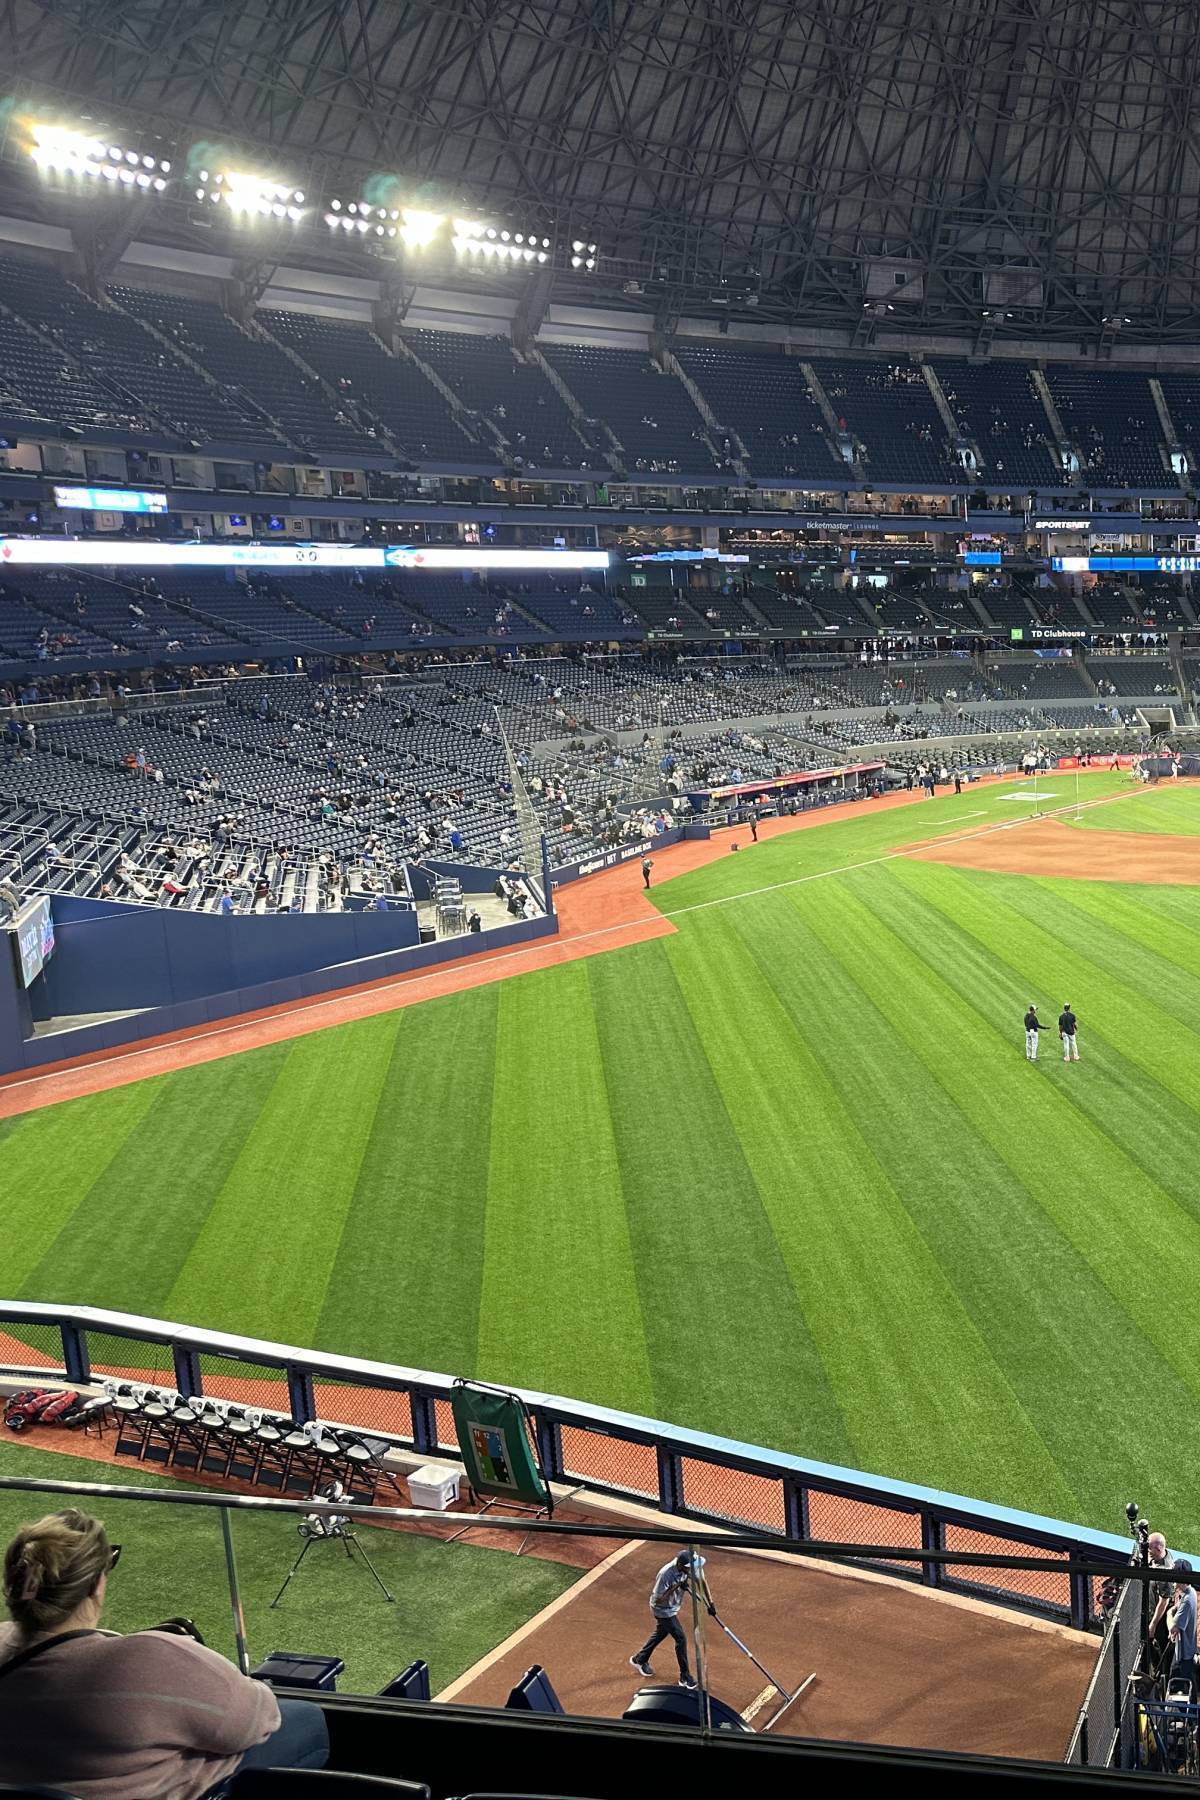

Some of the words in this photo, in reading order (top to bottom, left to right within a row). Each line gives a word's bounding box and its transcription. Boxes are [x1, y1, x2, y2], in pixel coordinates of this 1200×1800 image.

[806, 521, 849, 530] ticketmaster
[1035, 521, 1090, 529] SPORTSNET
[1031, 630, 1043, 638] TD
[1043, 630, 1086, 638] Clubhouse
